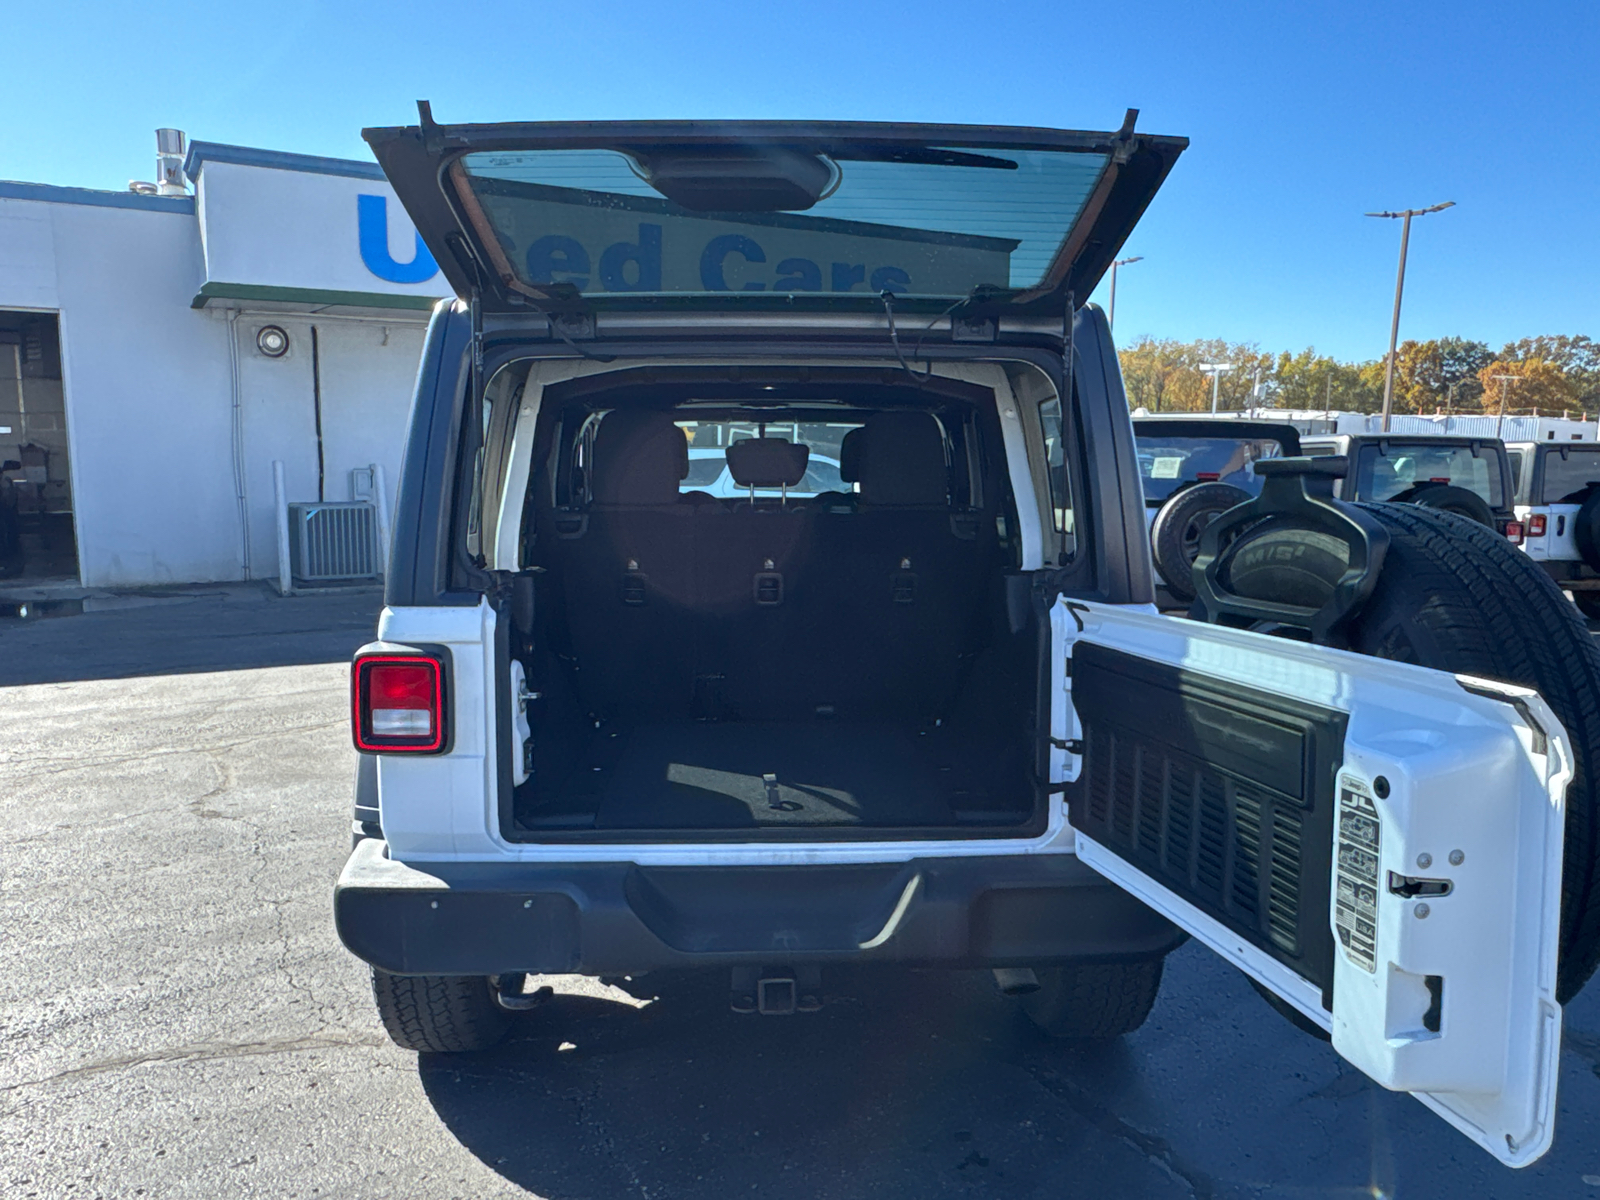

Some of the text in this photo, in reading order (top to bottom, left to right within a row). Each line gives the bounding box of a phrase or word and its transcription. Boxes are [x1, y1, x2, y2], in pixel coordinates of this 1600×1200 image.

[357, 194, 911, 294] Ued Cars
[1342, 793, 1375, 812] JL
